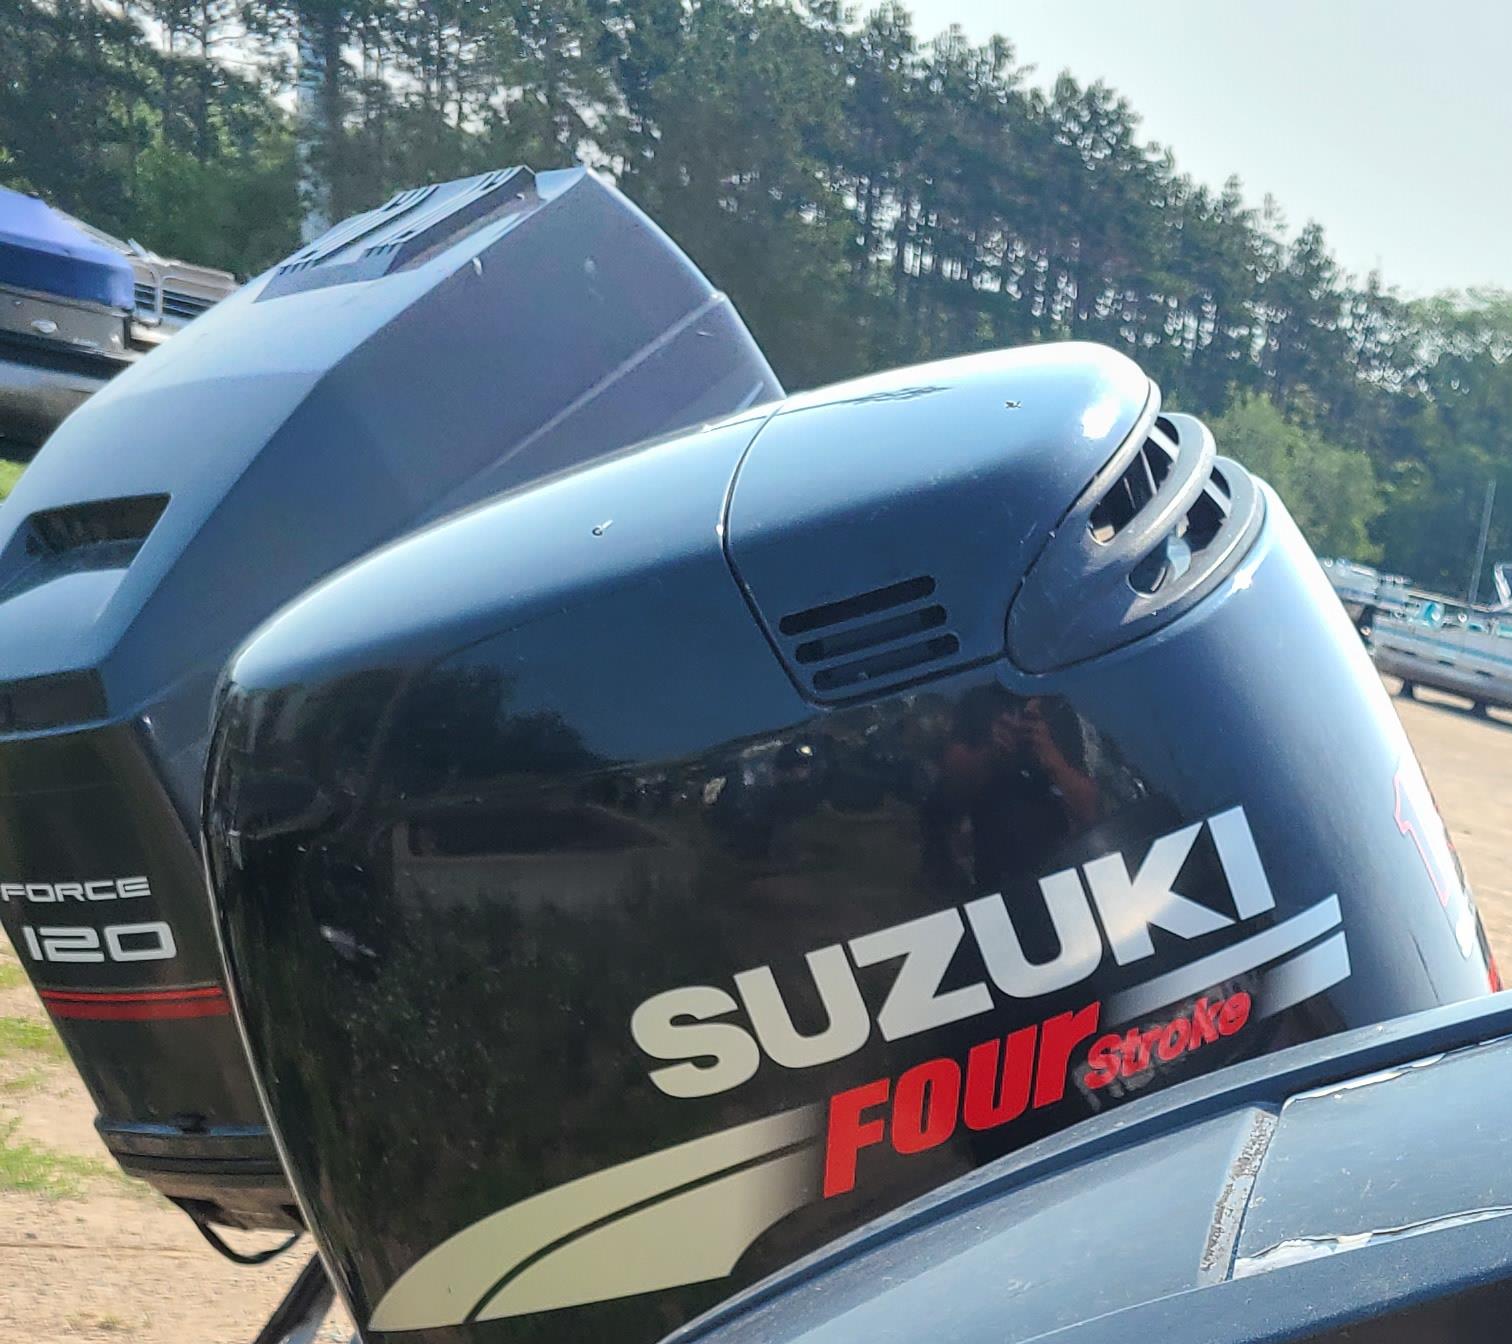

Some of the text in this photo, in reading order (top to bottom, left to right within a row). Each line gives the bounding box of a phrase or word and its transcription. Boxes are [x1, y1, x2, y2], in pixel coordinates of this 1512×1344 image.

[0, 875, 152, 902] FORCE
[22, 920, 178, 963] 120
[630, 804, 1276, 1099] SUZUKI
[1083, 991, 1252, 1090] Stroke
